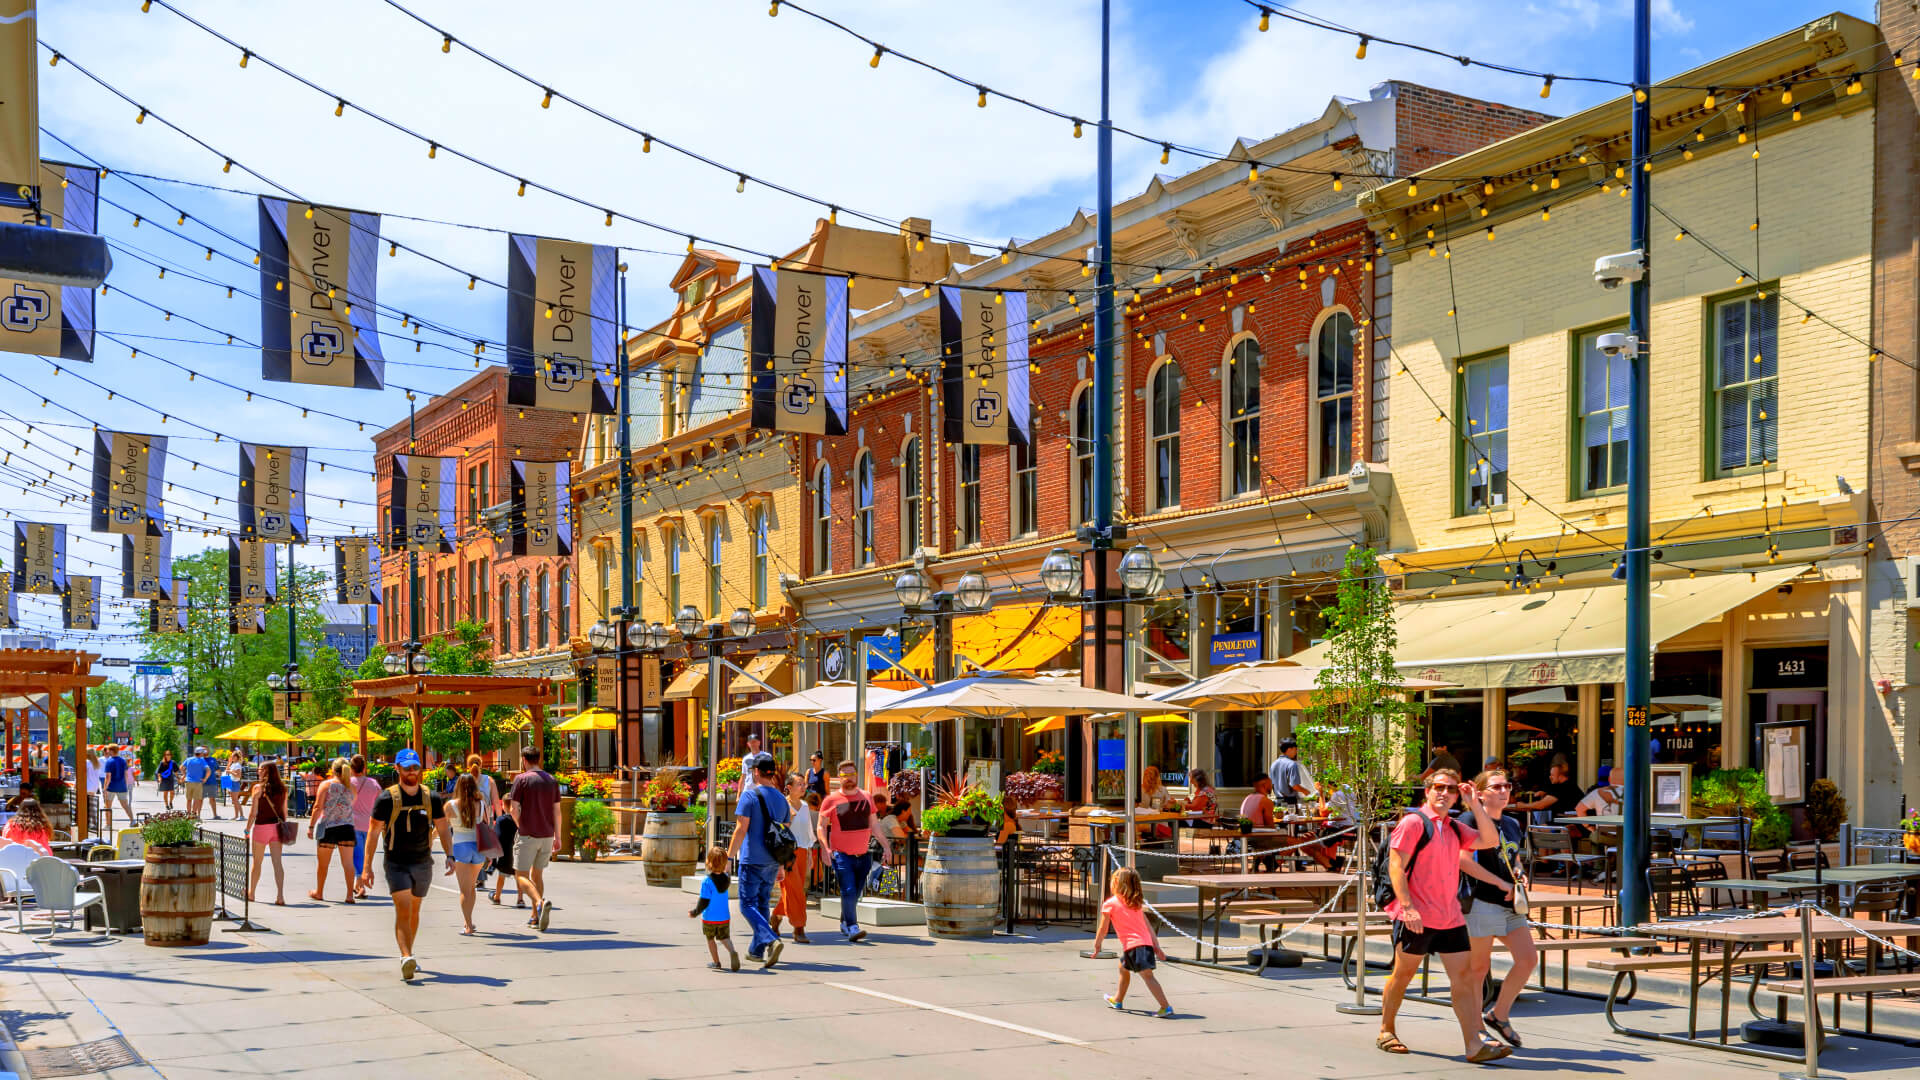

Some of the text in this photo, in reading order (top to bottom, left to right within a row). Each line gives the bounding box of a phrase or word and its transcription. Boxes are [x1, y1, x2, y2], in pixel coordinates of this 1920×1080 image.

[310, 220, 333, 310] Denver
[552, 255, 577, 343] Denver
[792, 285, 814, 364] Denver
[977, 302, 994, 379] Denver
[121, 442, 138, 494] Denver
[266, 456, 280, 505] Denver
[417, 465, 431, 513] Denver
[536, 469, 548, 517] Denver
[35, 530, 45, 566] Denver
[142, 536, 152, 573] Denver
[248, 541, 257, 577] Denver
[354, 544, 364, 577] Denver
[1213, 640, 1257, 653] PENDLETON
[1778, 660, 1805, 672] 1431
[600, 676, 614, 684] THIS
[1628, 718, 1646, 726] 402
